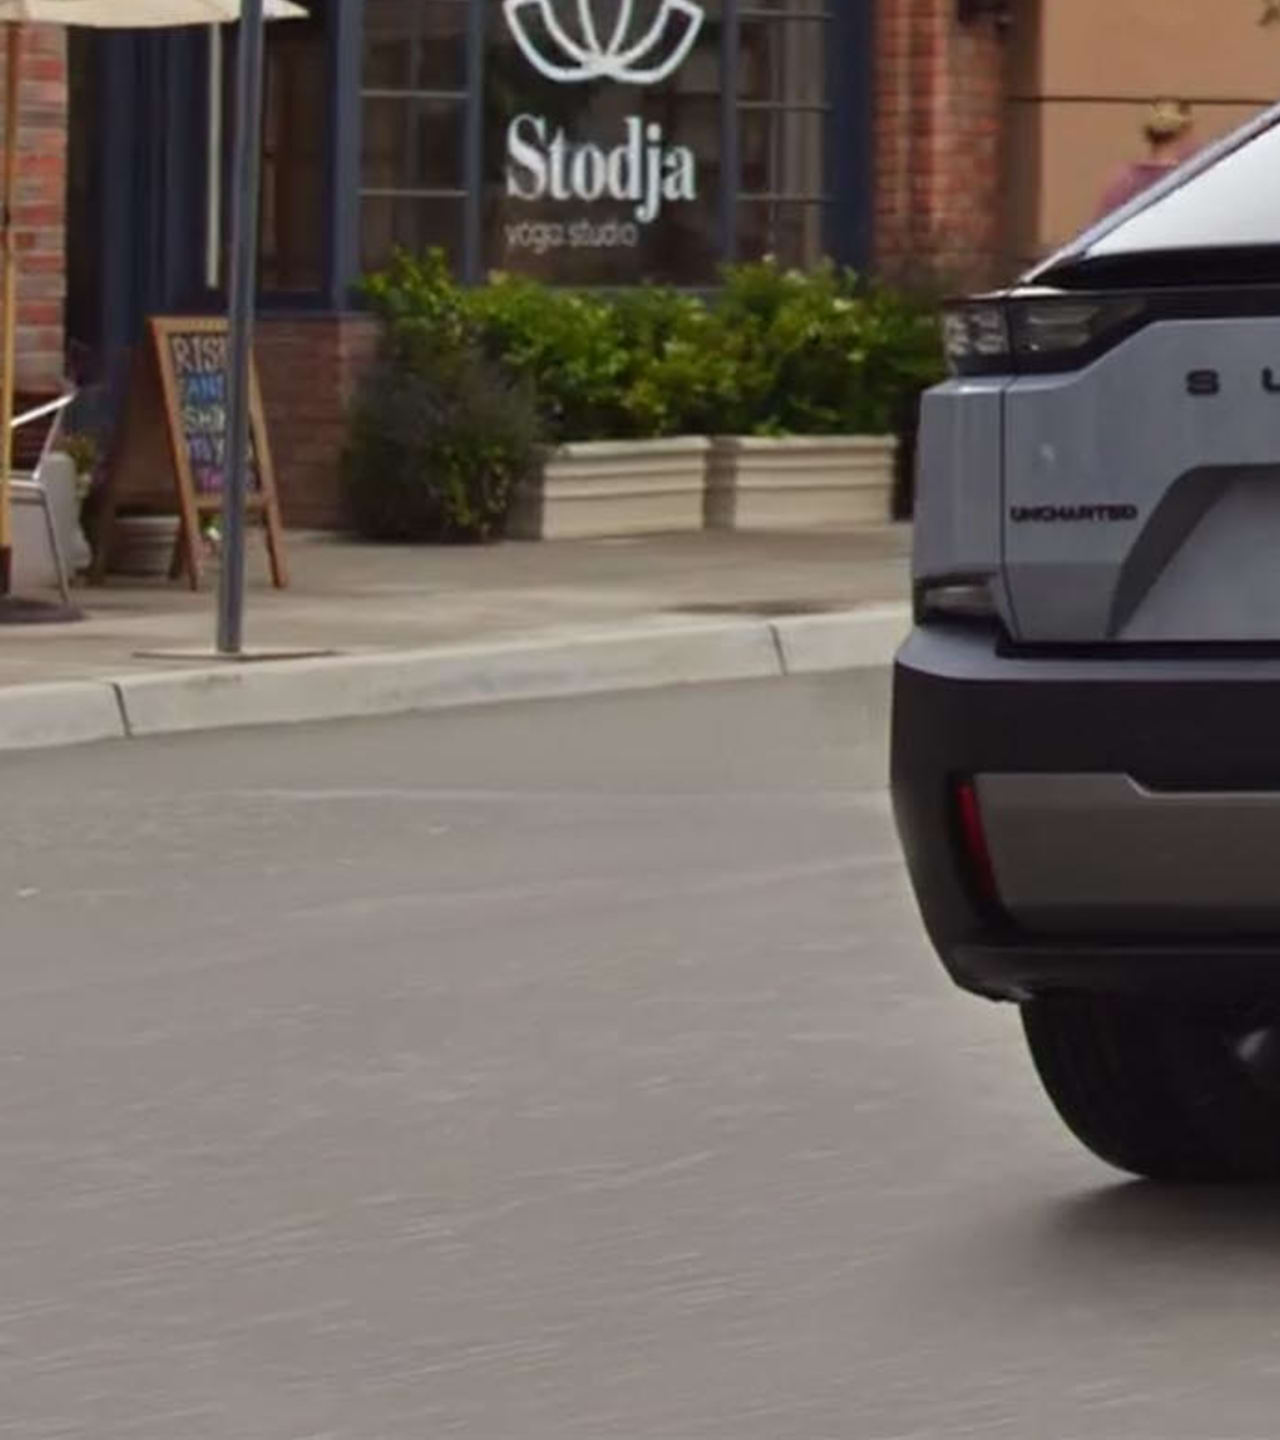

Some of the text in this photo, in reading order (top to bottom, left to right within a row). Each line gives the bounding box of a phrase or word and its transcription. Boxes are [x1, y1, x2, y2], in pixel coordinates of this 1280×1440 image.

[507, 113, 698, 224] Stodja
[504, 216, 639, 255] yoga studio
[187, 374, 225, 405] AN
[1009, 503, 1139, 523] UNCHARTED
